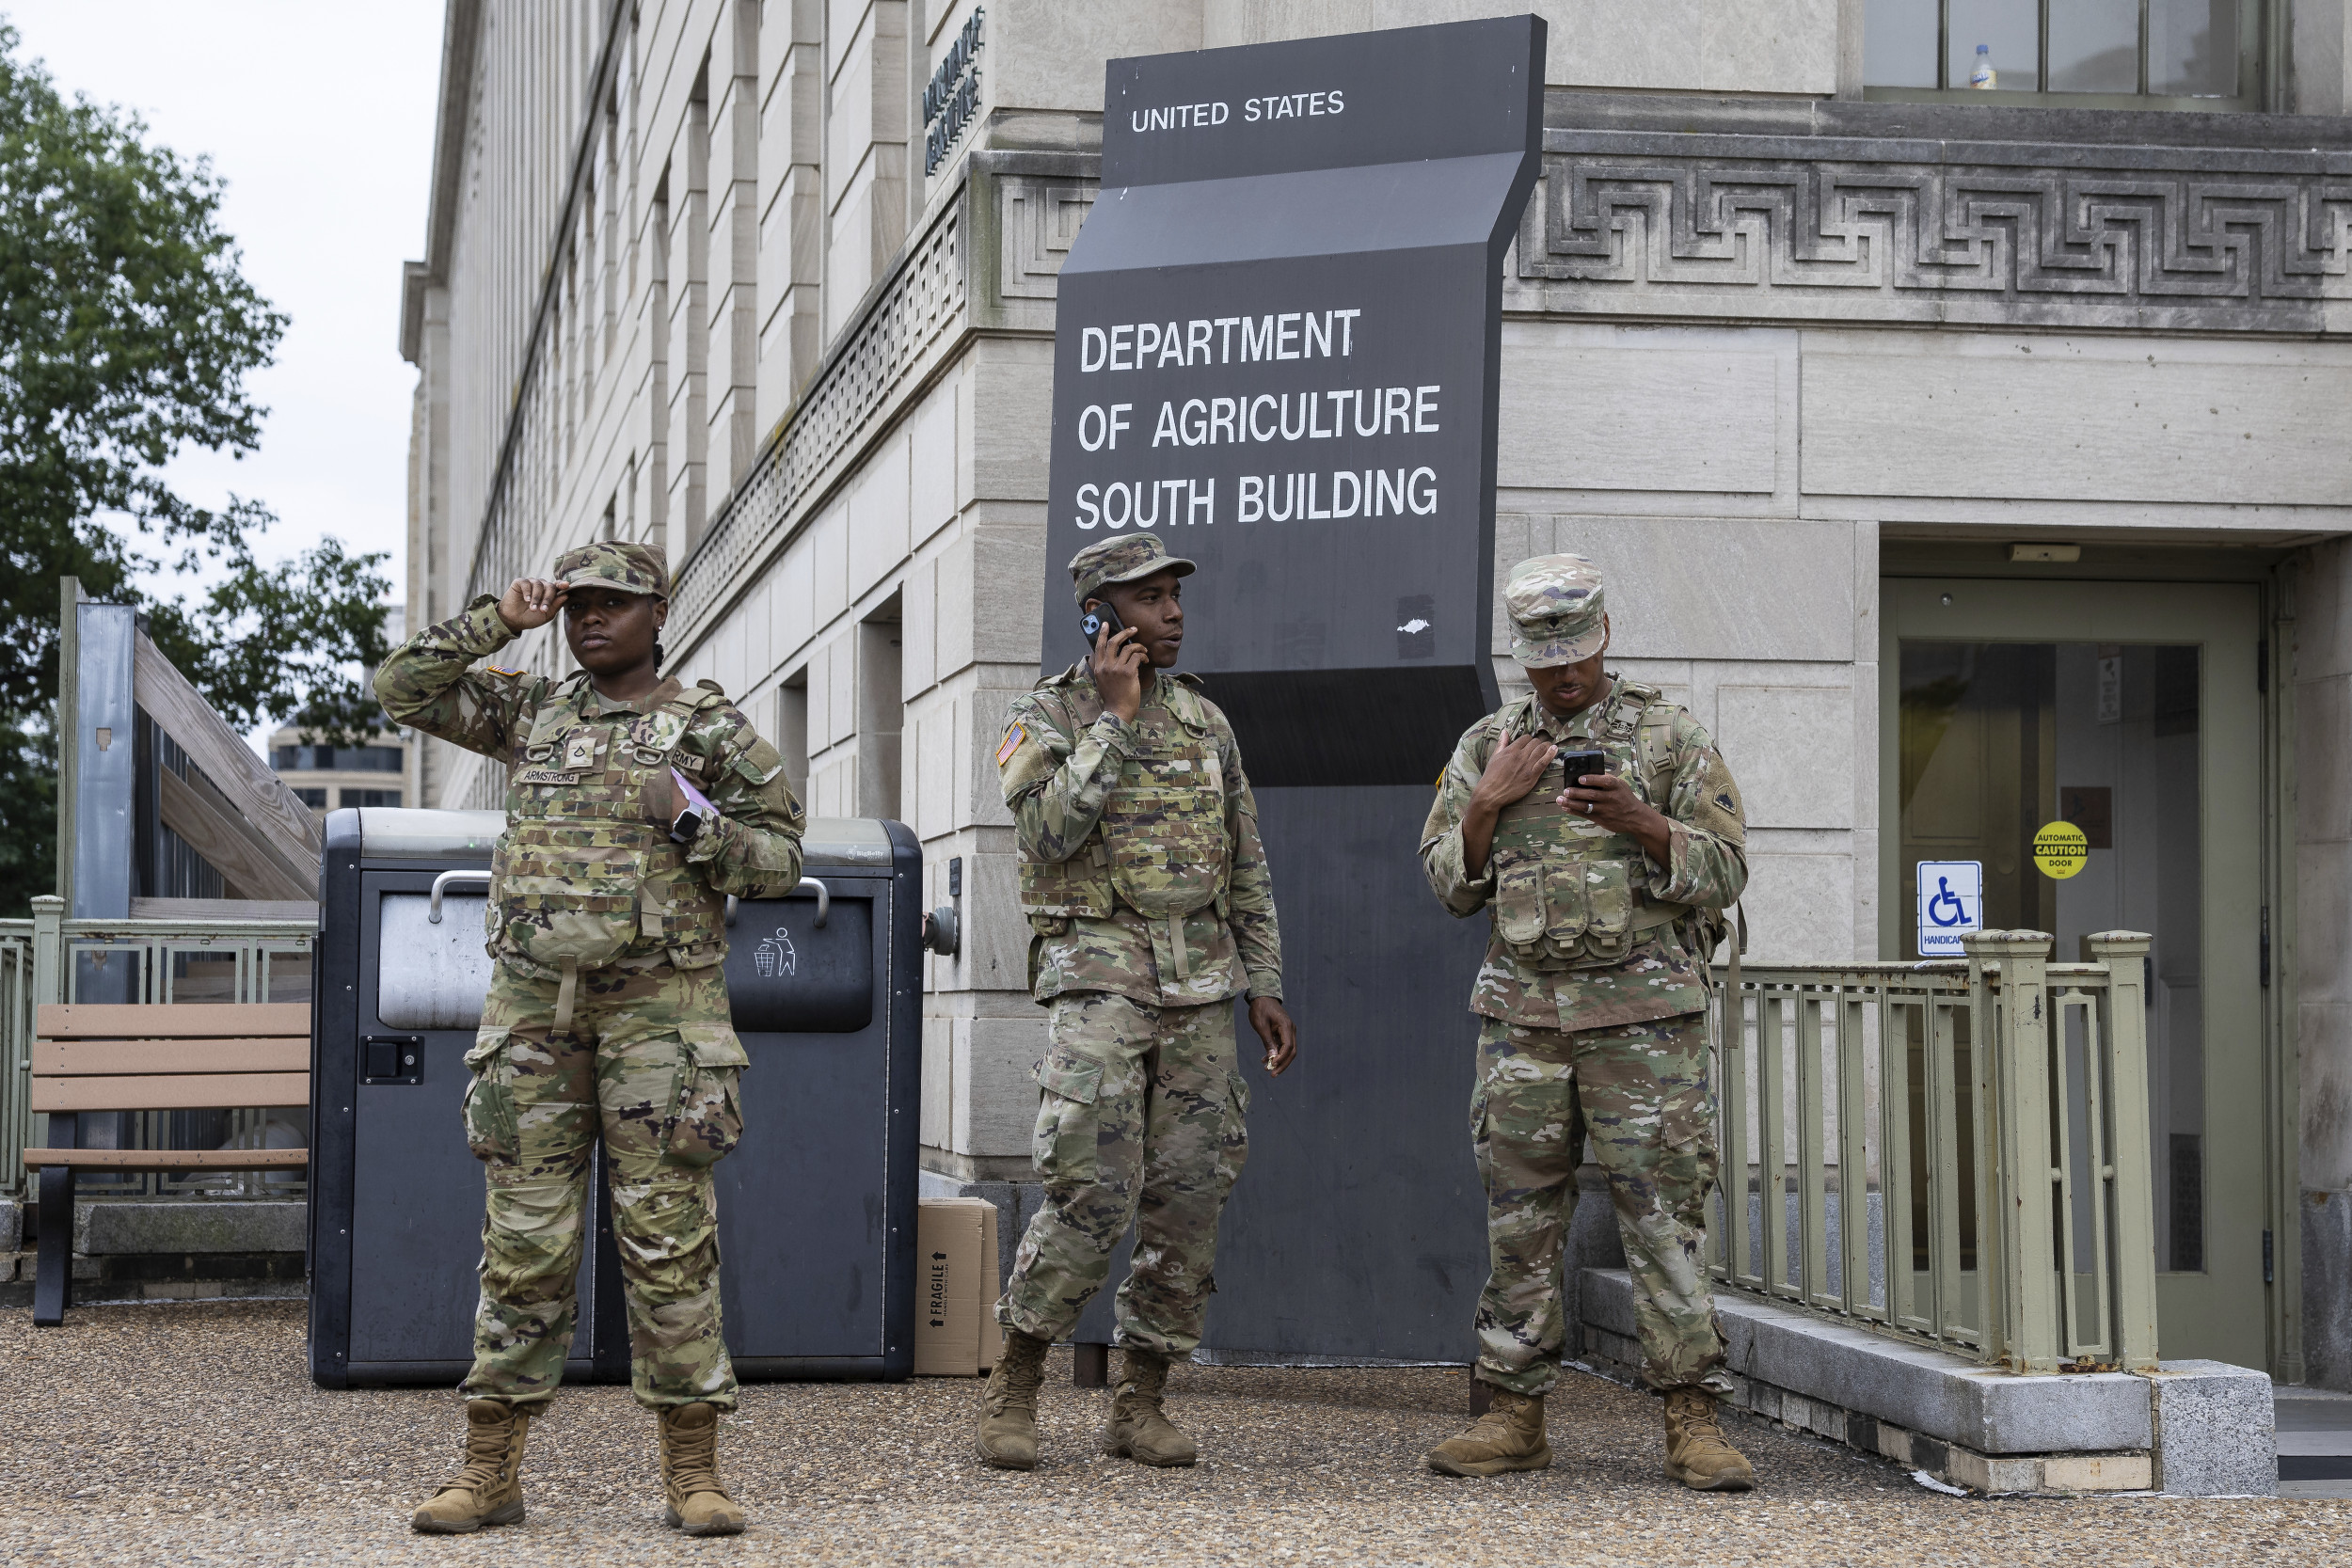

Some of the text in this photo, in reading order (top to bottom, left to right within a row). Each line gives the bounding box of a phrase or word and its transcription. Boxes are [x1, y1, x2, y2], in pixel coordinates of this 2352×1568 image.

[1132, 90, 1344, 133] UNITED STATES
[1081, 309, 1360, 372] DEPARTMENT
[1077, 385, 1440, 451] OF AGRICULTURE
[1075, 467, 1438, 530] SOUTH BUILDING
[524, 770, 575, 783] ARMSTRONG
[673, 750, 697, 767] RMY
[2035, 845, 2086, 855] CAUTION
[930, 1265, 944, 1315] FRAGILE
